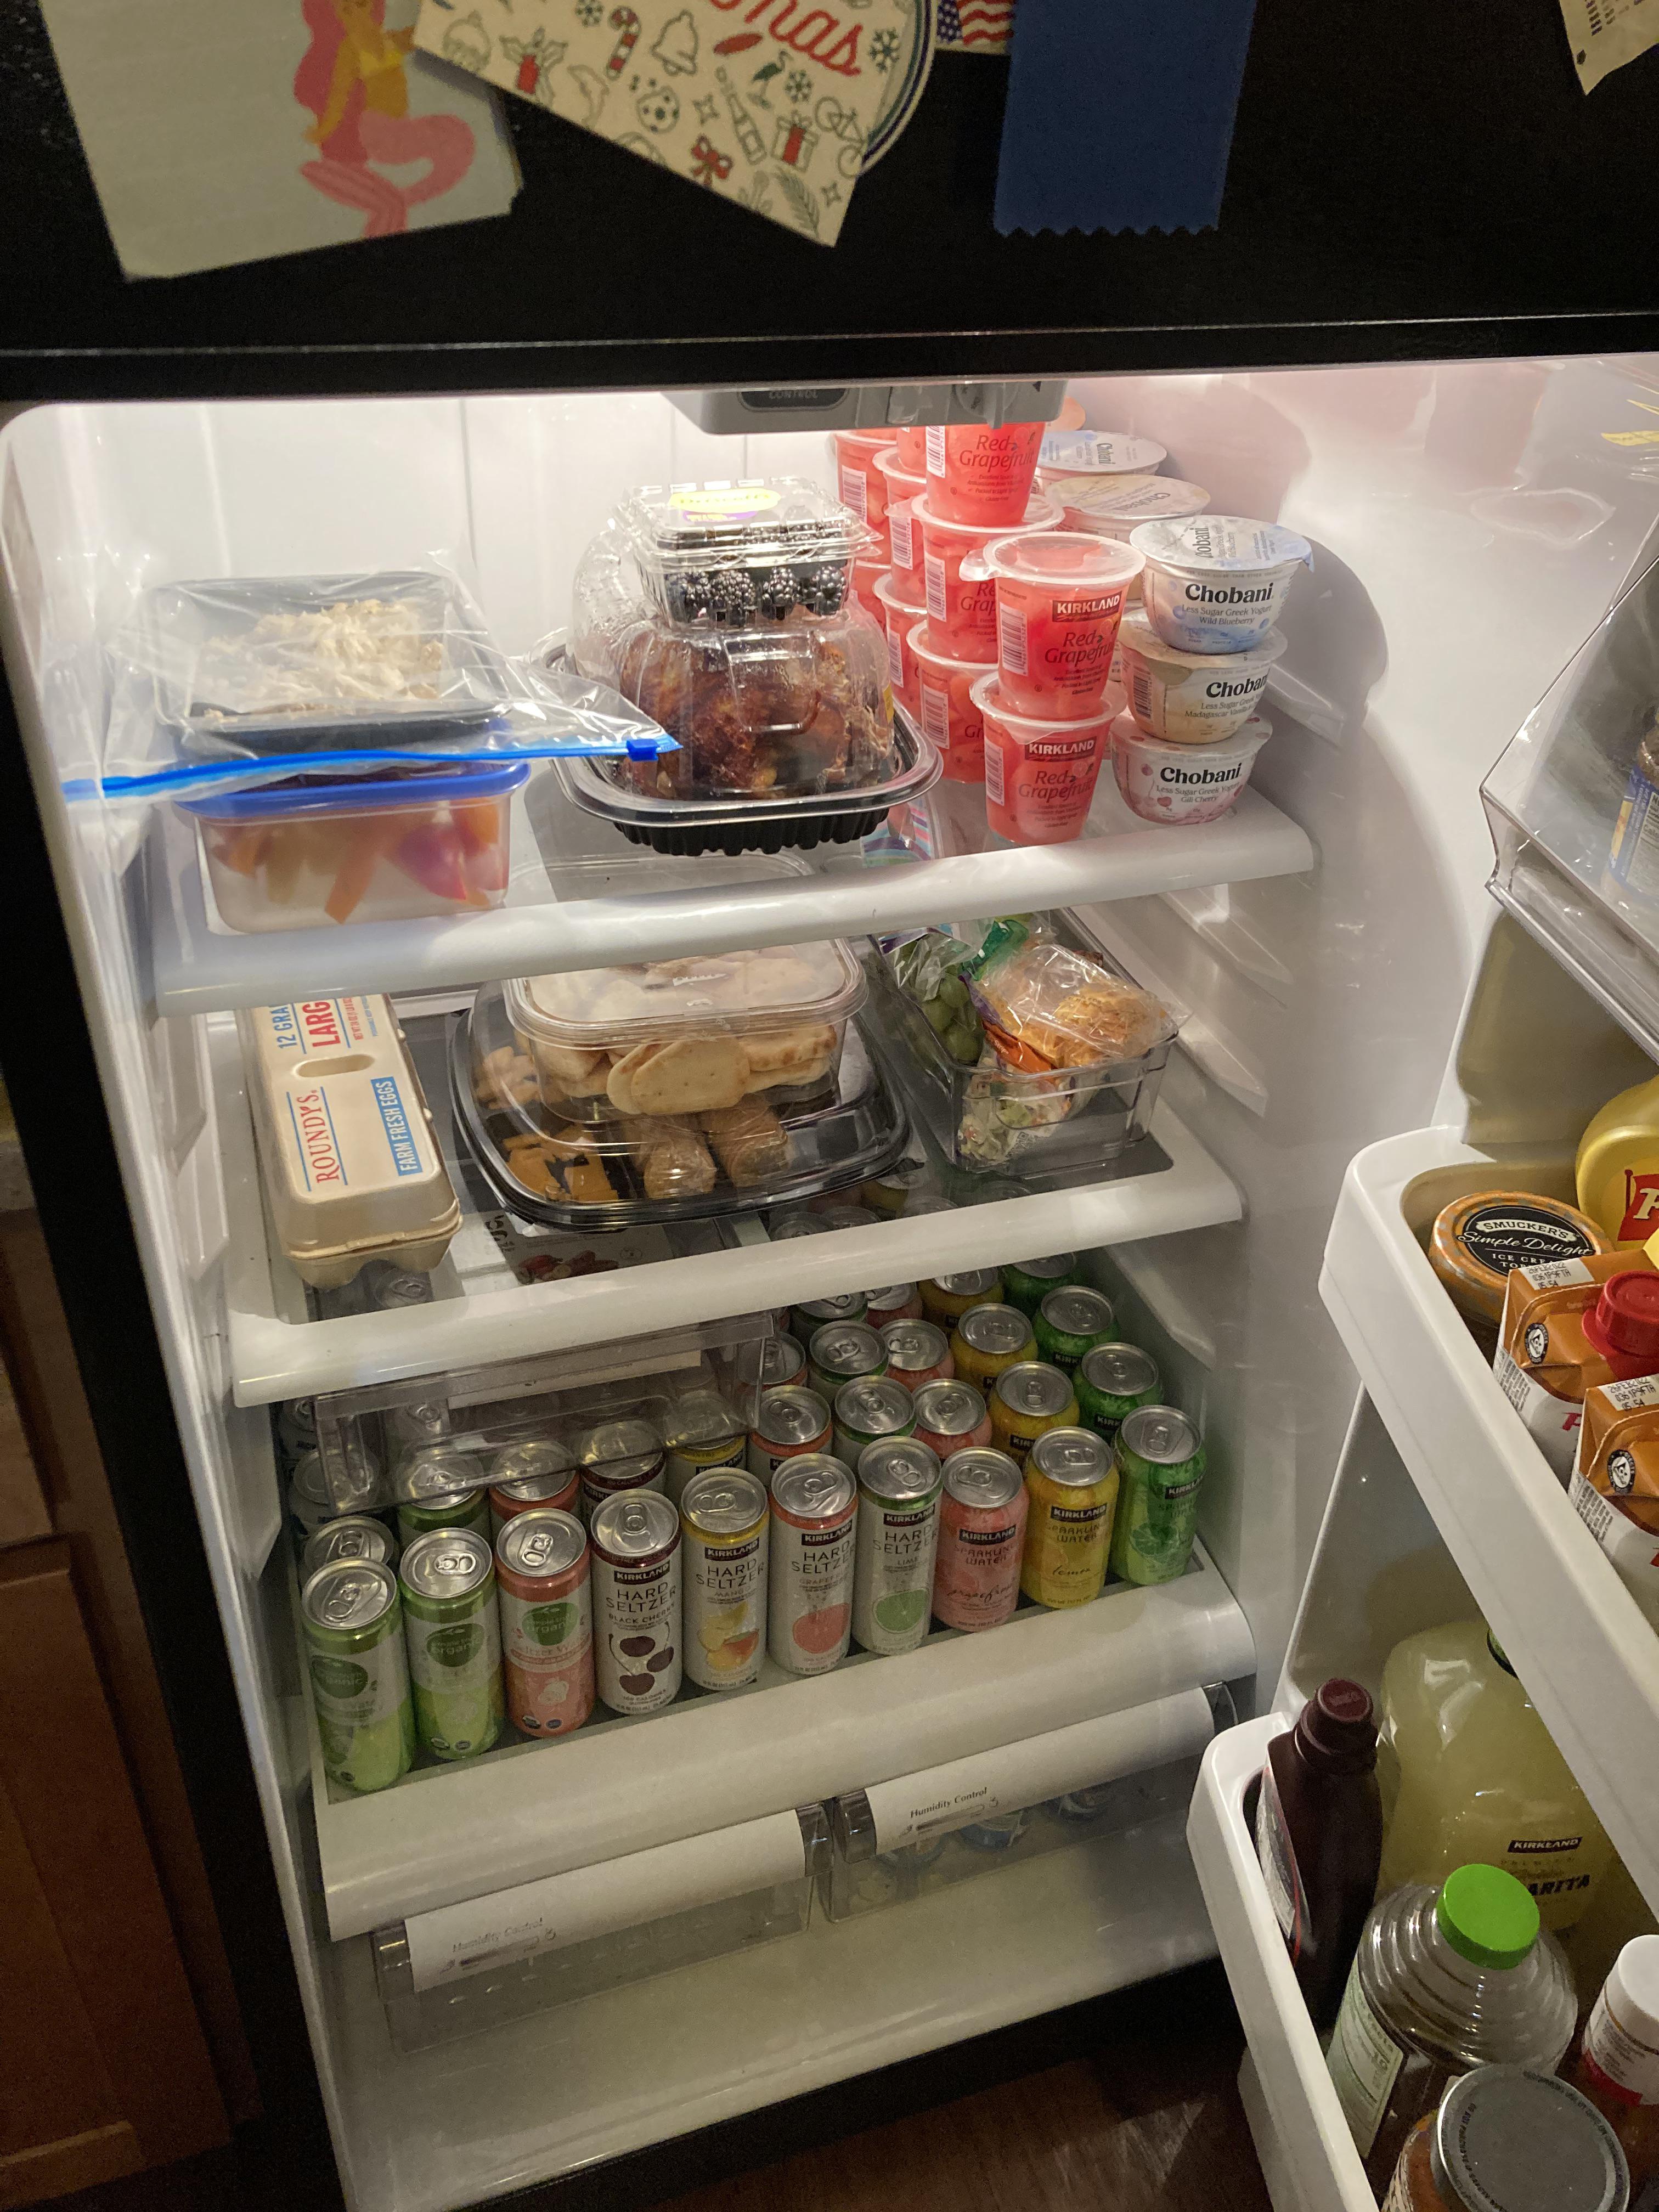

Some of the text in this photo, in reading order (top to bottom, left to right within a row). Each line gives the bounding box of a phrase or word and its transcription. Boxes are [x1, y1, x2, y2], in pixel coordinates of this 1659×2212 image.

[977, 435, 1009, 451] Red
[960, 448, 1035, 472] Grapefruit
[1186, 583, 1273, 603] Chobani
[1057, 595, 1120, 614] KIRKLAND
[1182, 605, 1272, 616] Less Sugar Greek Yogurt
[1199, 617, 1255, 625] Wild Blueberry
[1063, 630, 1096, 647] Red
[1219, 701, 1239, 709] Sugar
[1185, 710, 1228, 719] Madagascar
[1029, 740, 1094, 755] KIRKLAND
[1035, 770, 1068, 785] Red
[1160, 763, 1242, 785] Chobani
[1019, 779, 1093, 803] Grapefruit
[1156, 785, 1173, 794] Less
[1175, 787, 1197, 796] Sugar
[1198, 787, 1220, 795] Greek
[1195, 795, 1217, 803] Cherry
[276, 1034, 297, 1049] 12
[379, 1080, 419, 1172] FARM FRESH EGGS
[297, 1096, 340, 1183] ROUNDY'S
[1483, 1221, 1568, 1239] SMUCKER'S
[1458, 1231, 1591, 1256] Simple Delight
[1053, 1505, 1107, 1518] KIRKLAND
[805, 1520, 852, 1542] KIRKLAND
[885, 1524, 932, 1542] HARD
[962, 1527, 1015, 1541] KIRKLAND
[708, 1539, 758, 1556] KIRKLAND
[804, 1540, 850, 1562] HARD
[617, 1563, 669, 1580] KIRKLAND
[696, 1561, 764, 1589] SELTZER
[708, 1559, 757, 1577] HARD
[606, 1585, 676, 1613] SELTZER
[617, 1582, 668, 1600] HARD
[609, 1613, 639, 1624] BLACK
[911, 1786, 987, 1818] Humidity Control
[1514, 1838, 1579, 1849] KIRKLAND
